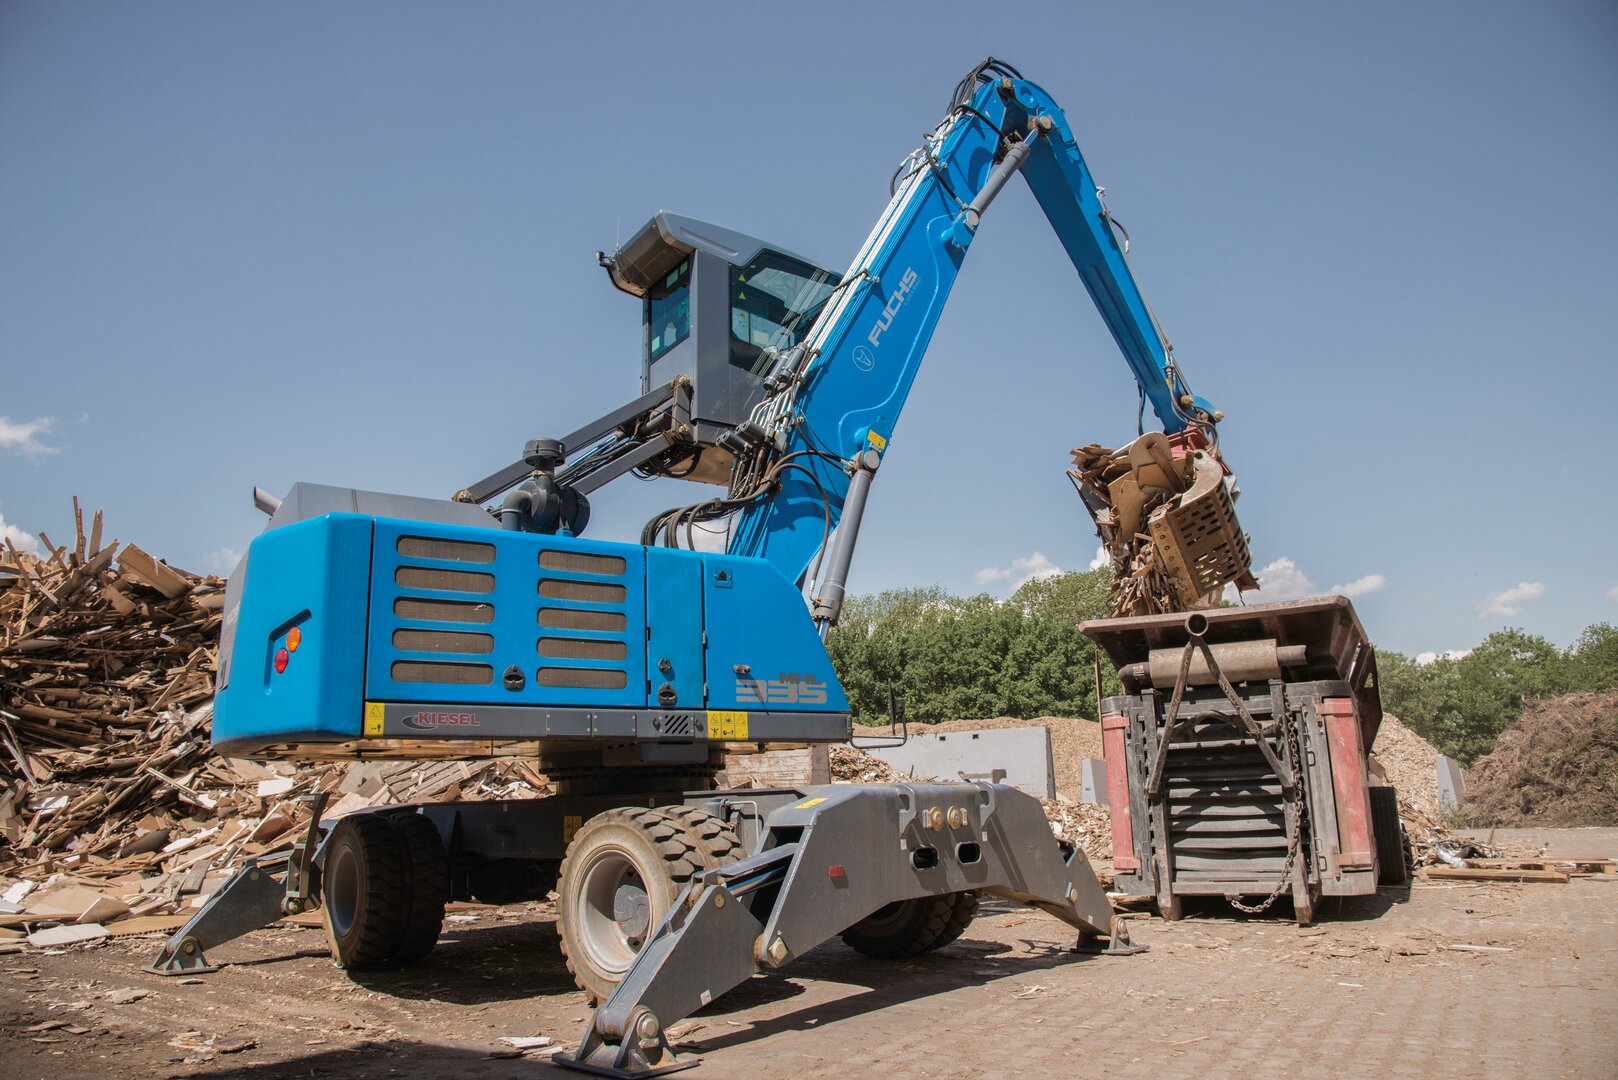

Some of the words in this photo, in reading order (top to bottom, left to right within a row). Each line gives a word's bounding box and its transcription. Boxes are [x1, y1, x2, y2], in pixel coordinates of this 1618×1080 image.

[867, 266, 918, 348] FUCHS
[735, 678, 827, 704] 335
[417, 711, 480, 726] KIESEL
